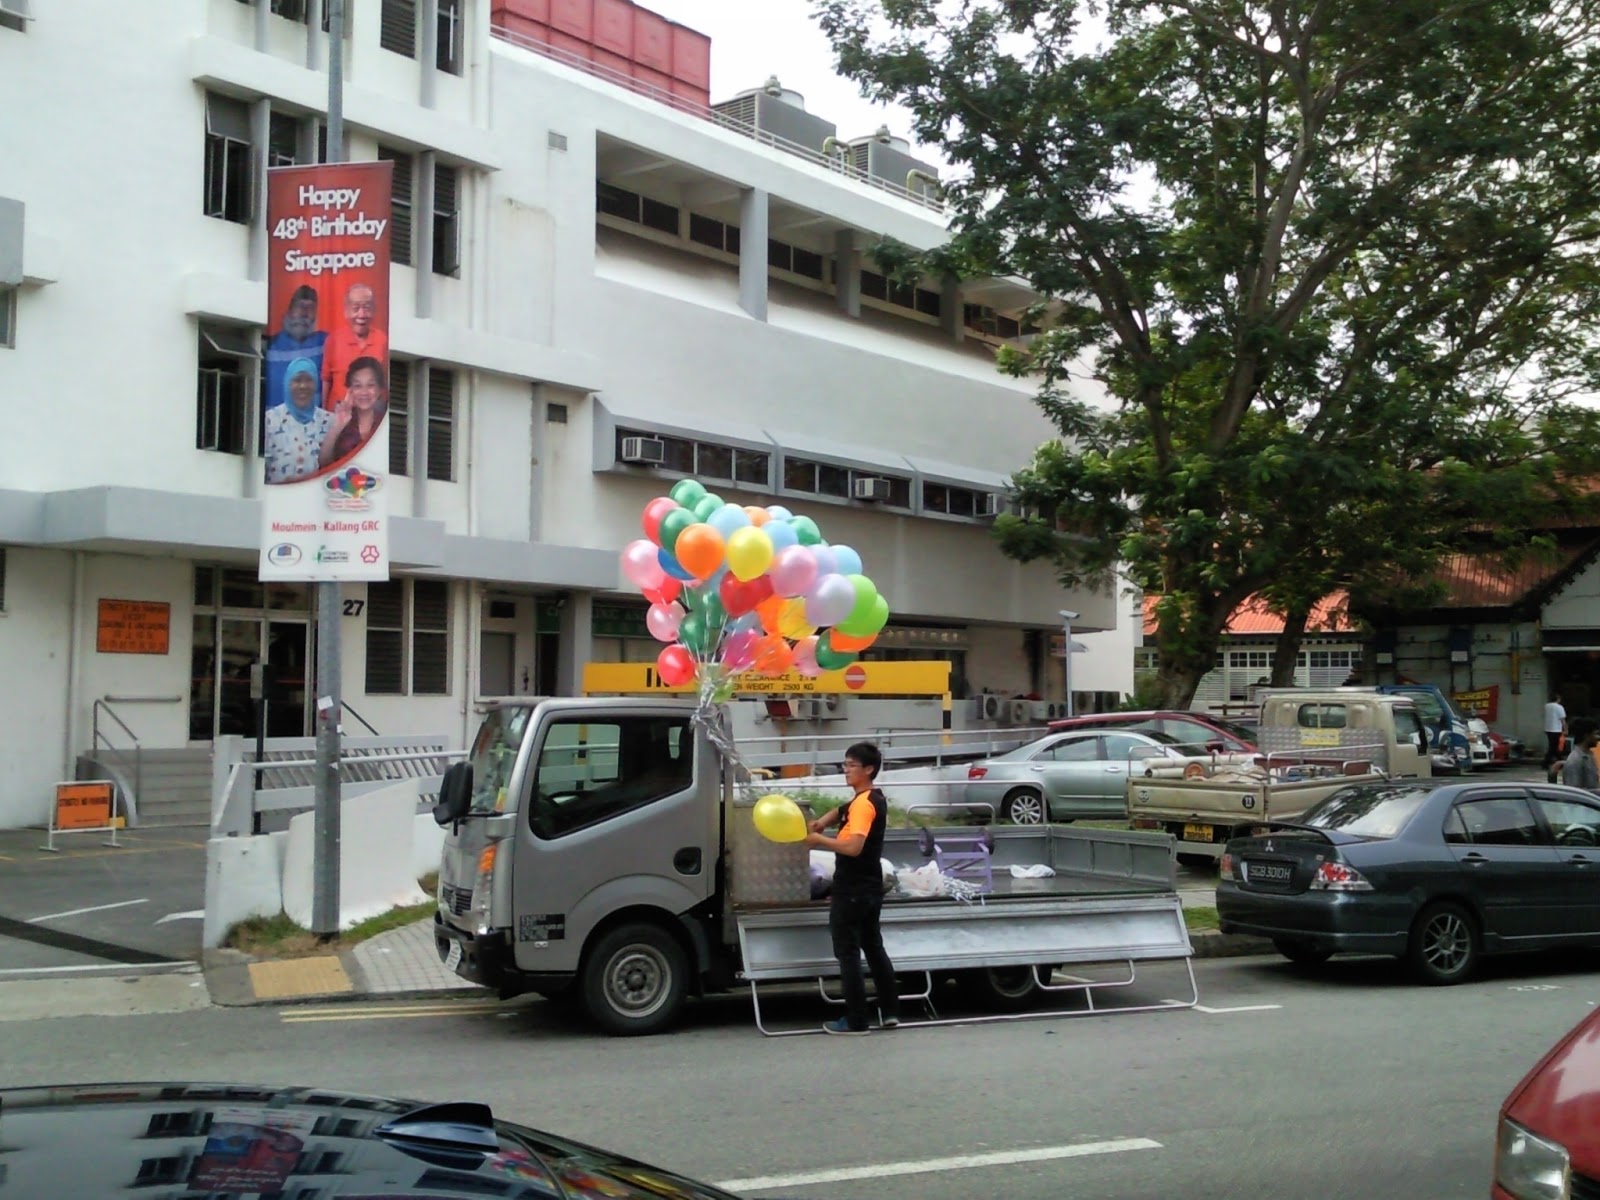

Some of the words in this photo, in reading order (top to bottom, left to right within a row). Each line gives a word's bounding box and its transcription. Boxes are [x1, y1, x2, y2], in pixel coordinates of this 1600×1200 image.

[299, 184, 361, 210] Happy
[273, 216, 307, 240] 48th
[311, 211, 387, 240] Birthday
[285, 249, 375, 275] Singapore
[272, 521, 317, 532] Moulmein
[323, 521, 360, 533] Kallang
[361, 520, 380, 531] GRC
[343, 599, 365, 616] 27
